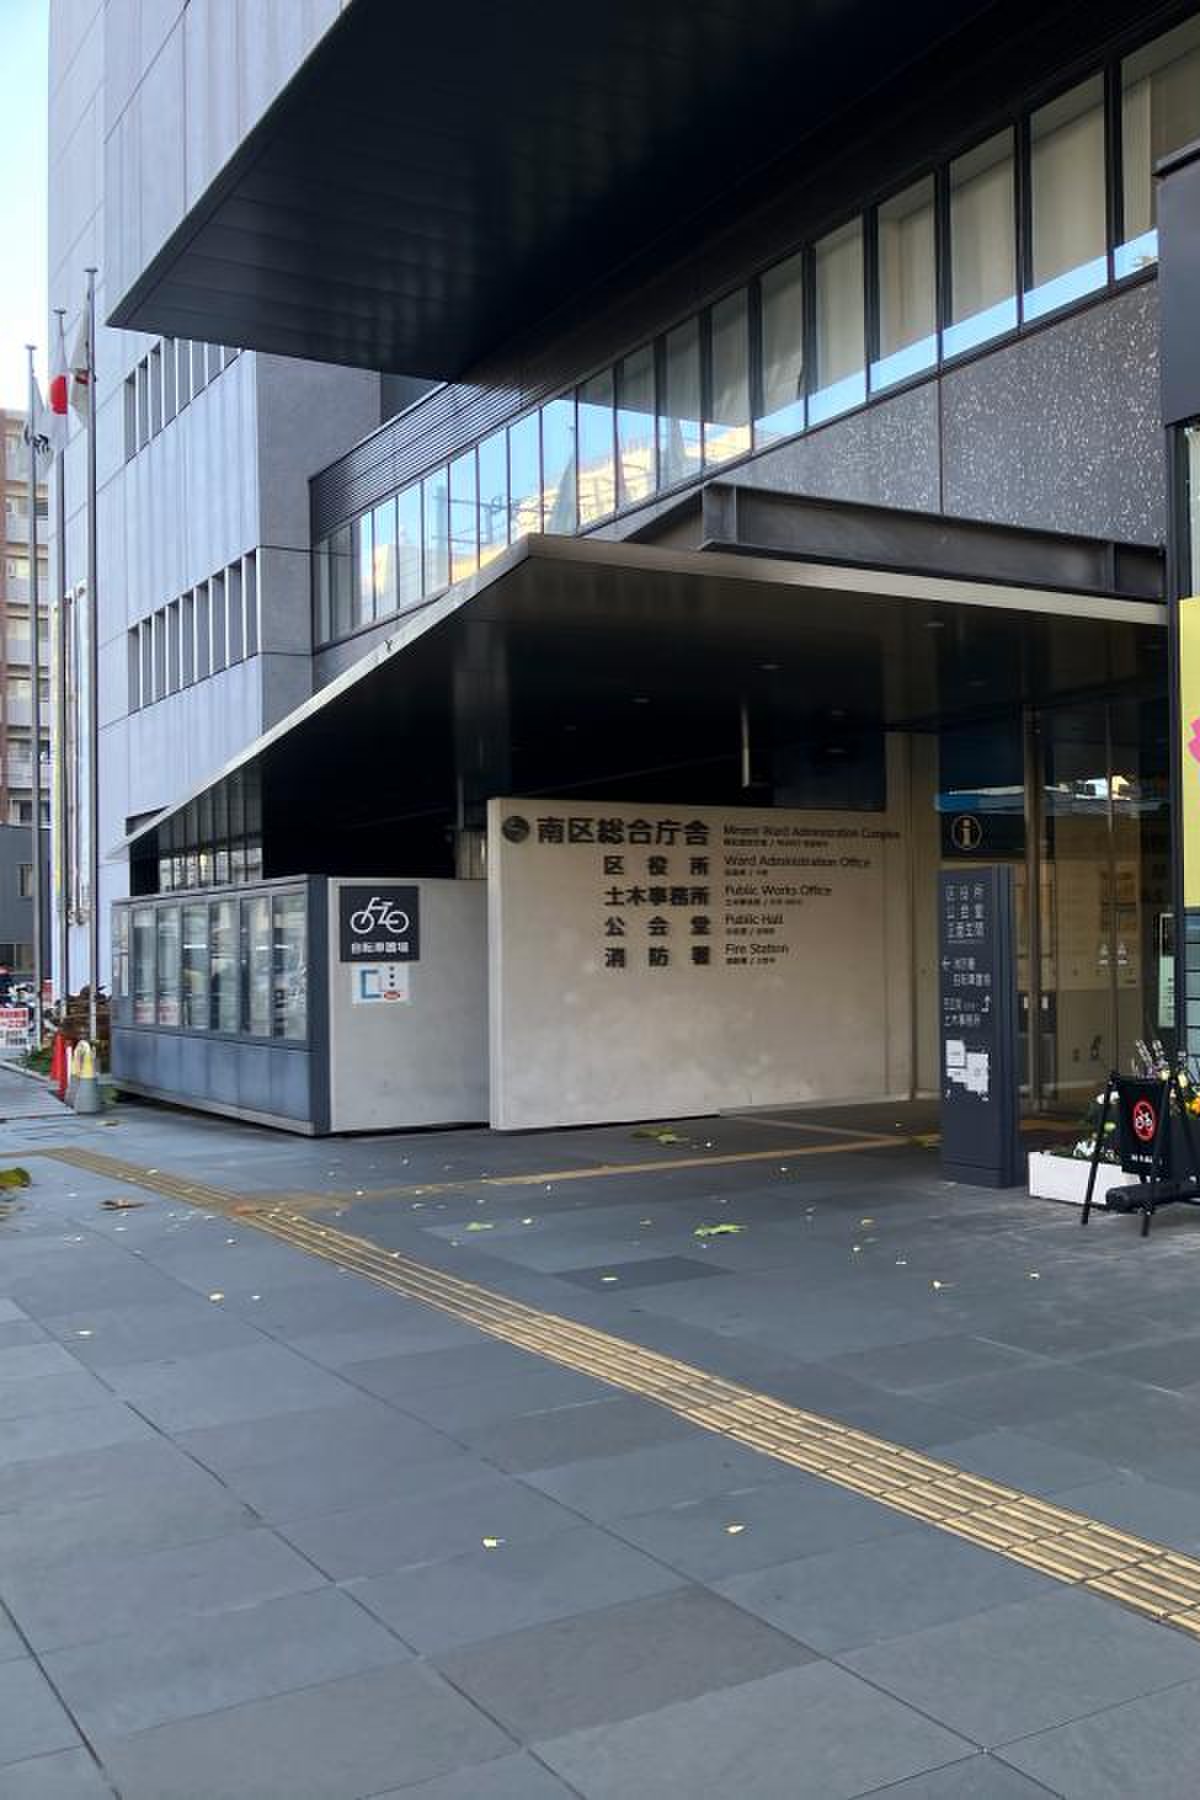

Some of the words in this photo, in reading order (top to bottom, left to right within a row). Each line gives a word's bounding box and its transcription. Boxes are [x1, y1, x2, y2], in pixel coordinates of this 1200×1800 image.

[537, 817, 710, 845] 南区総合庁舎
[725, 884, 758, 897] Public
[800, 885, 832, 897] Office
[725, 943, 748, 955] Fire
[750, 943, 789, 956] Station
